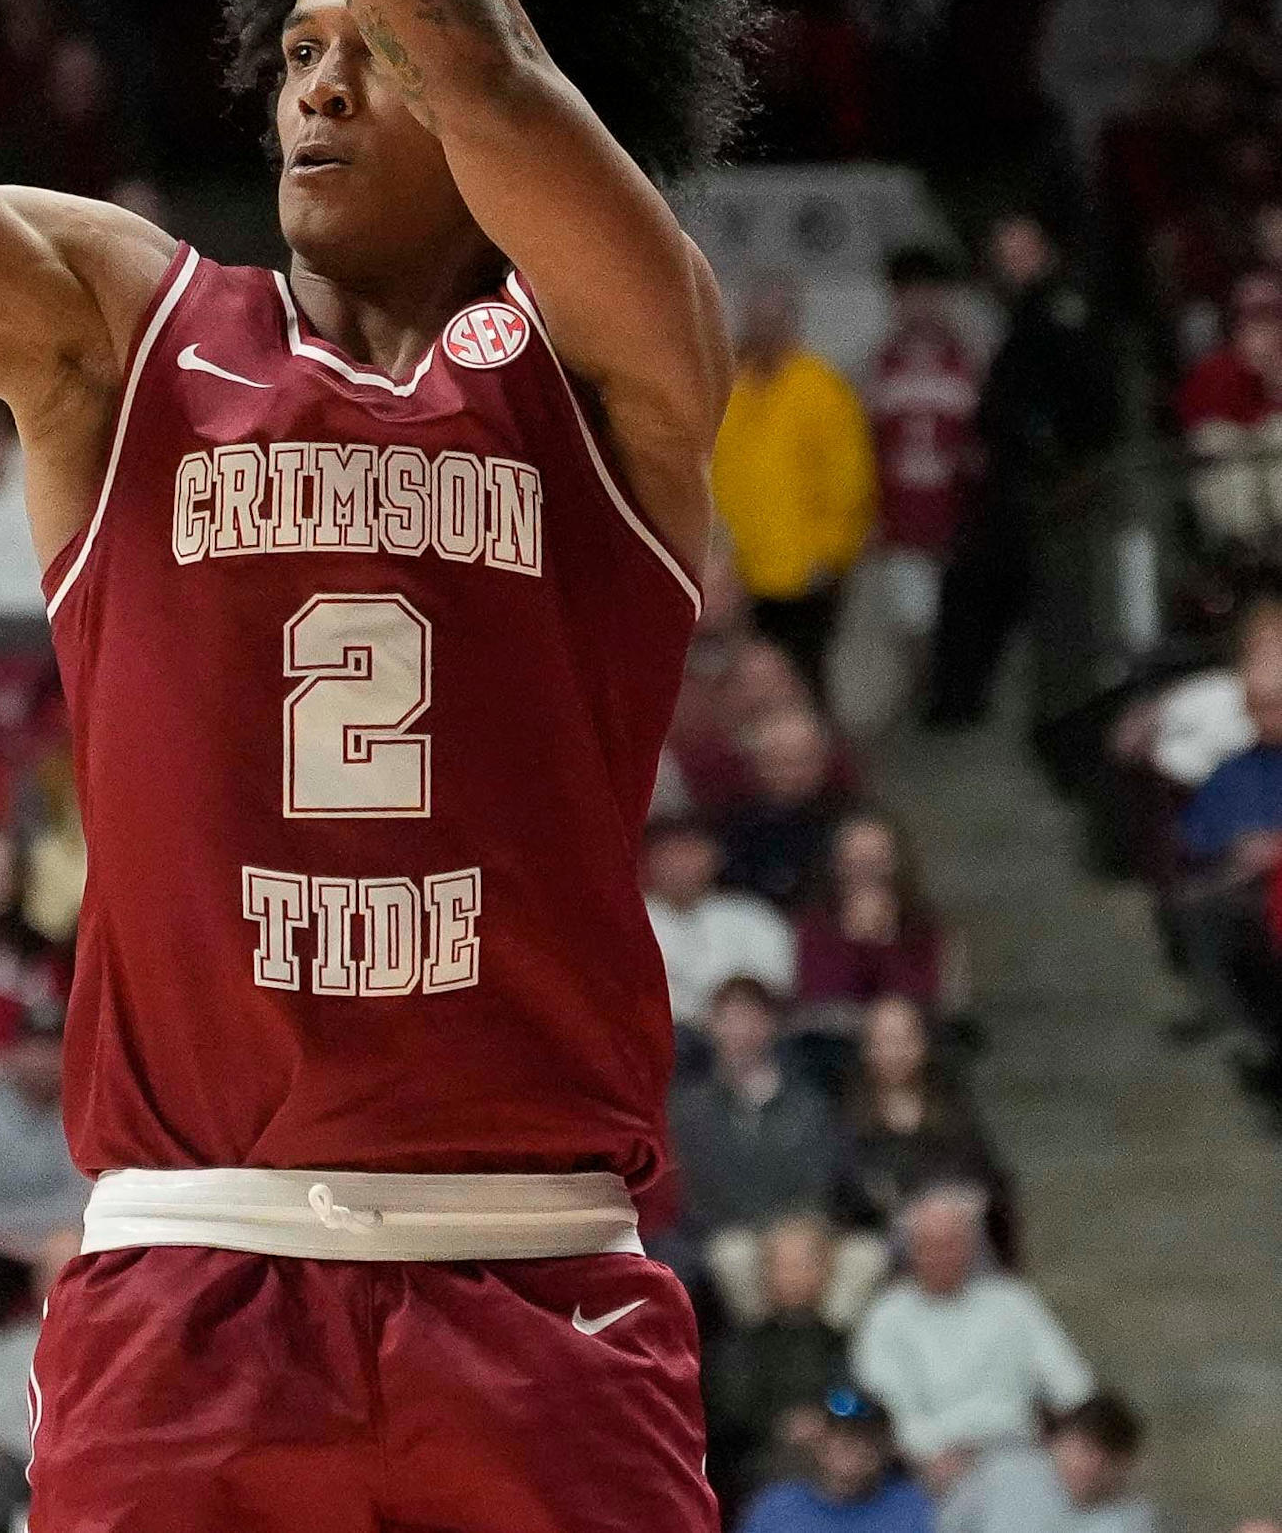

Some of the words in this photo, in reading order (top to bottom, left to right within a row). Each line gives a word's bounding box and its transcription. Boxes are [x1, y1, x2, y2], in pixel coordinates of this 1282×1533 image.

[447, 307, 523, 364] SEC
[172, 442, 544, 577] CRIMSON
[283, 593, 432, 819] 2
[241, 866, 482, 997] TIDE
